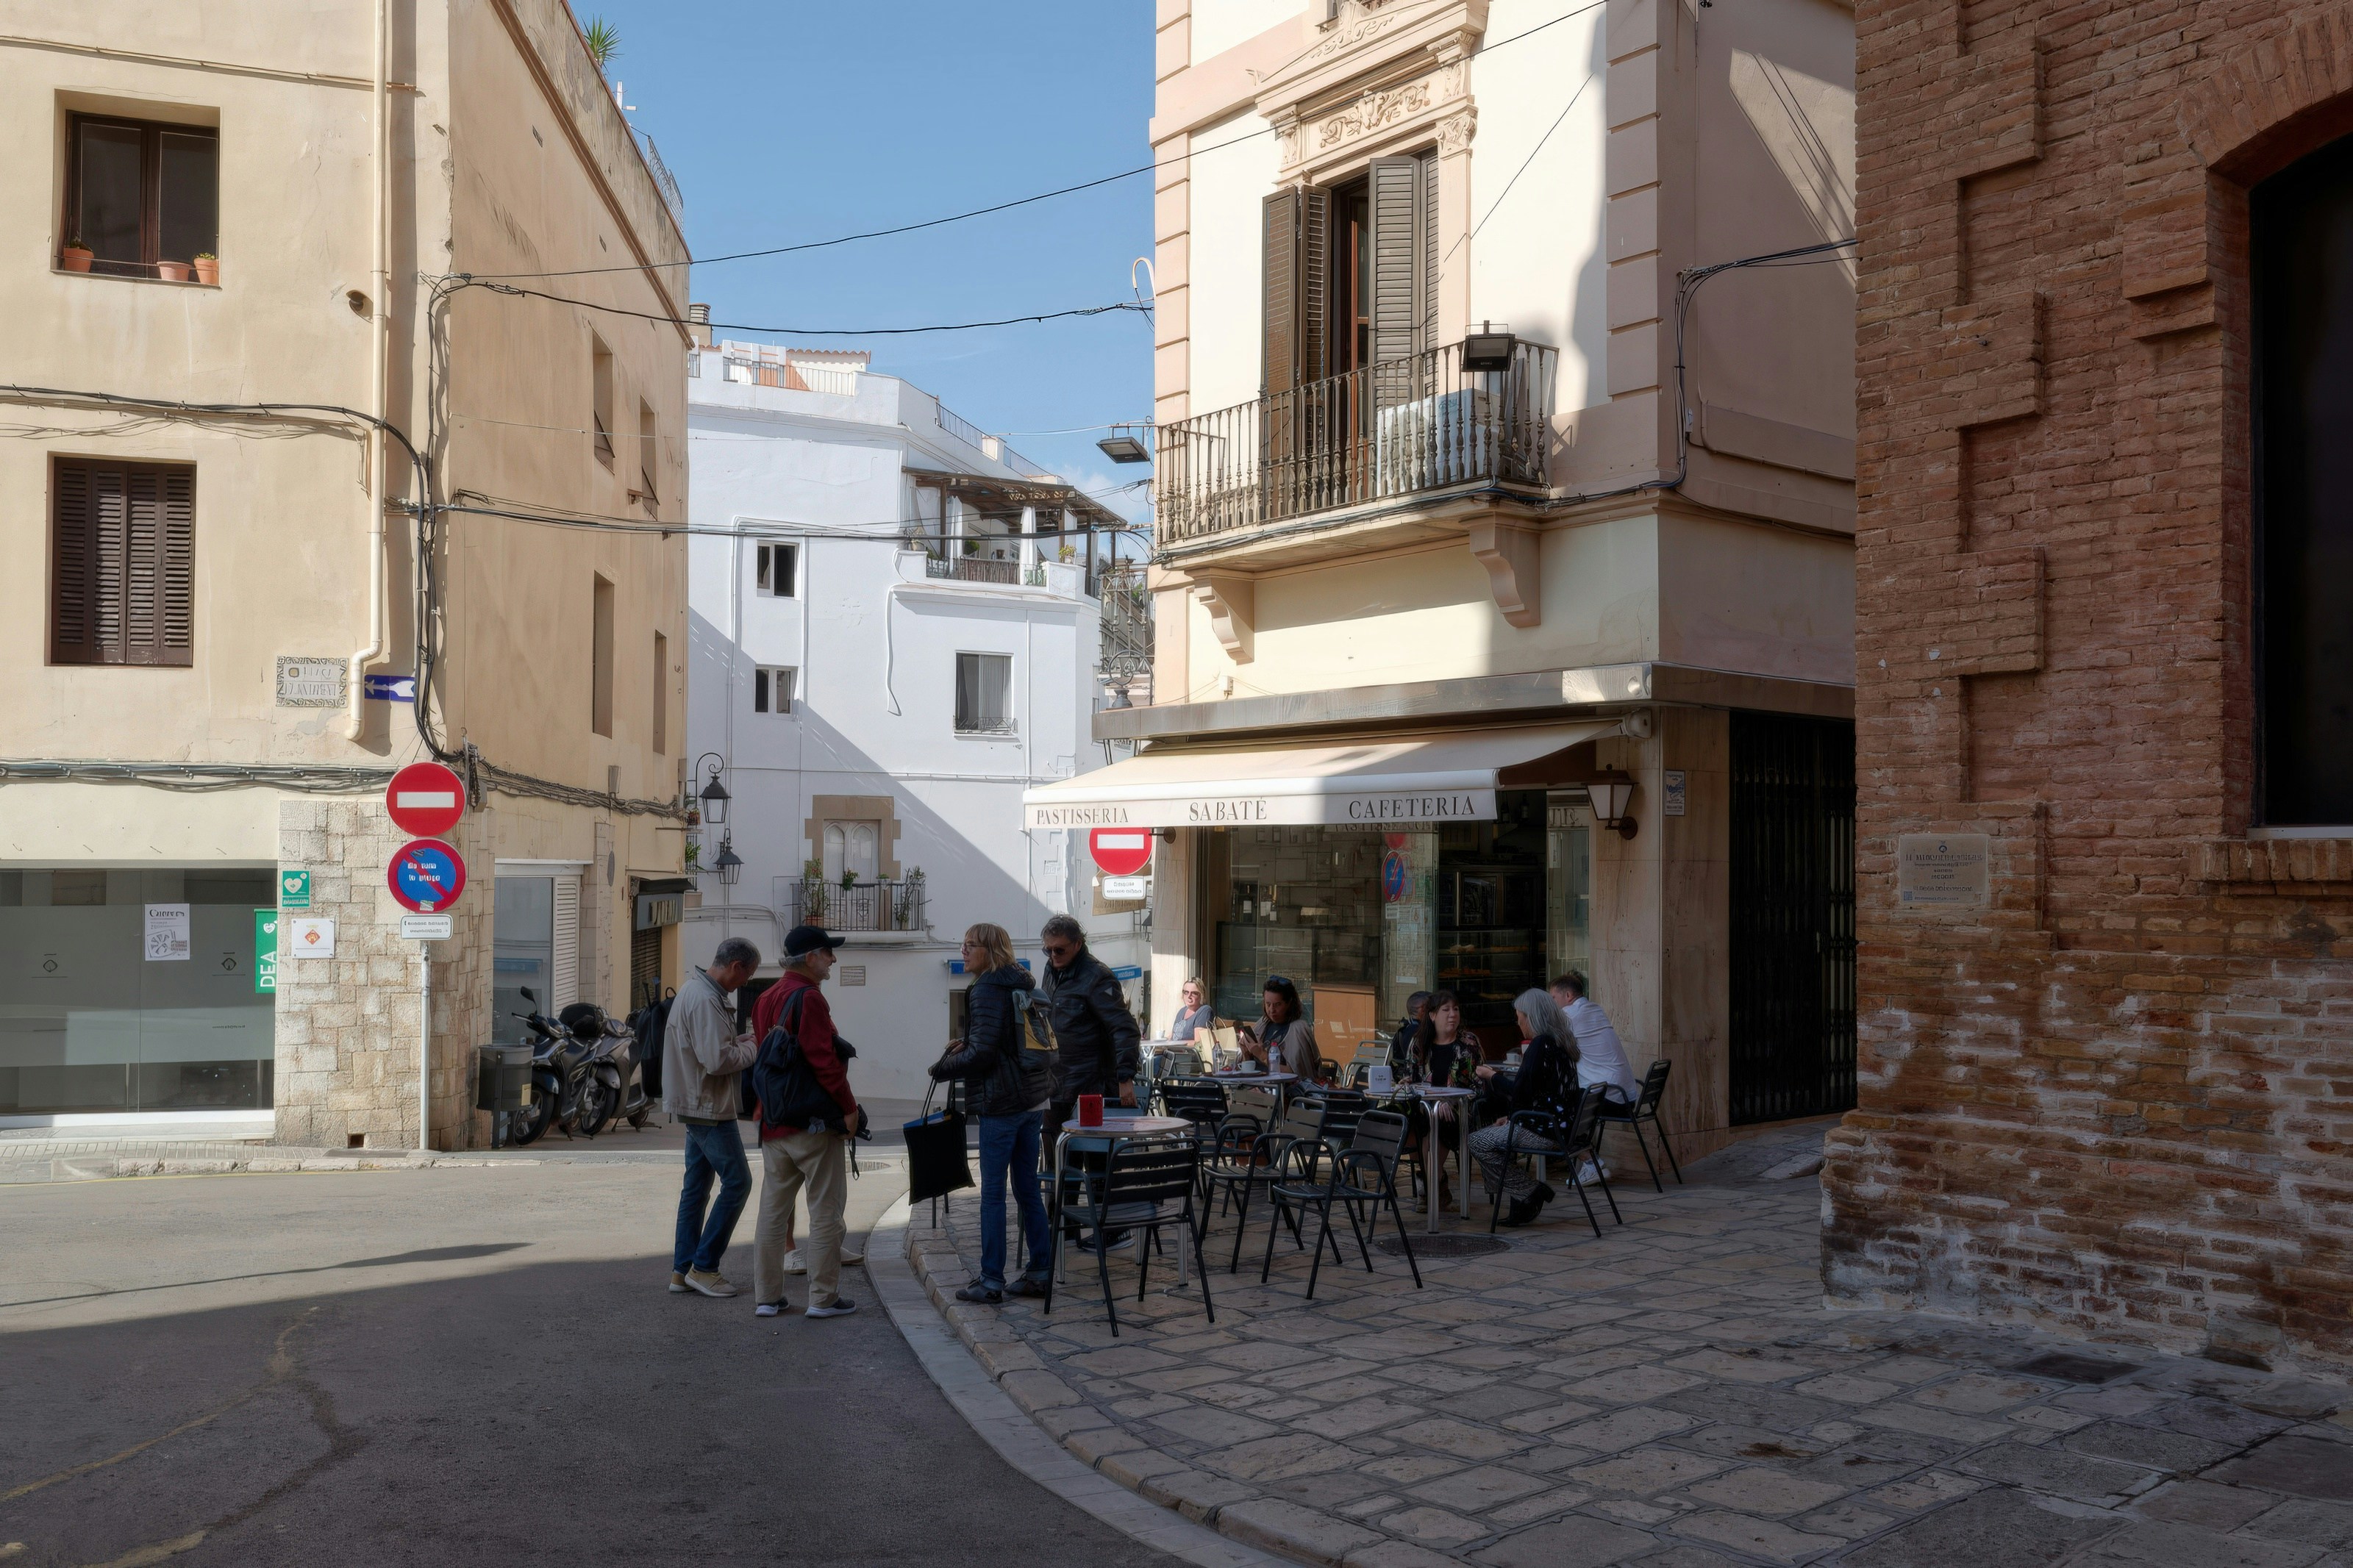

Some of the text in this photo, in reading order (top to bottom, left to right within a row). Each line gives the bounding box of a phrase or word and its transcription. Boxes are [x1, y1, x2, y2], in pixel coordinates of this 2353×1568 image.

[1037, 795, 1476, 825] PASTISSERIA SABATÉ CAFETERIA
[260, 951, 276, 987] DEA
